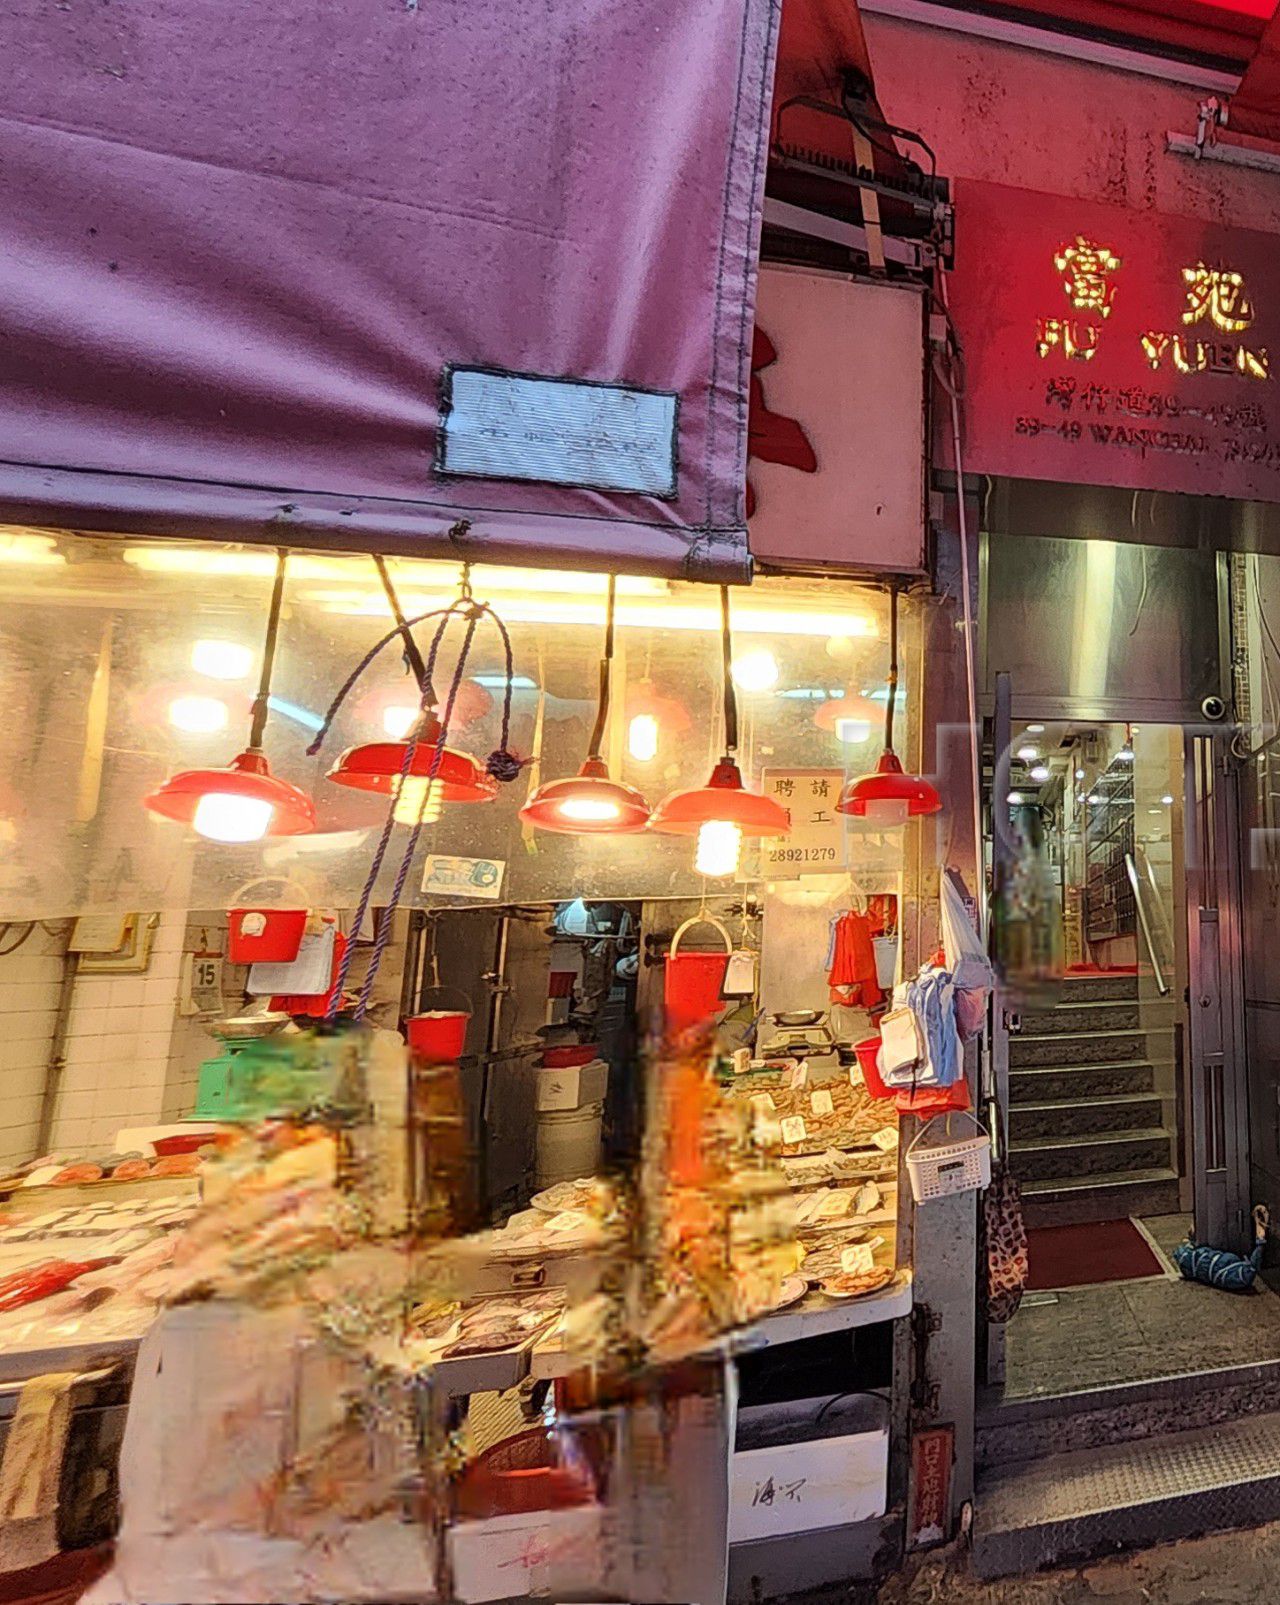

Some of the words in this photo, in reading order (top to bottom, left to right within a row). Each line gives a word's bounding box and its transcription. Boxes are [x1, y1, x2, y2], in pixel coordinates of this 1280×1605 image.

[1036, 317, 1102, 361] FU
[1140, 330, 1273, 380] YUEN
[769, 847, 836, 862] 28921279
[198, 963, 215, 986] 15
